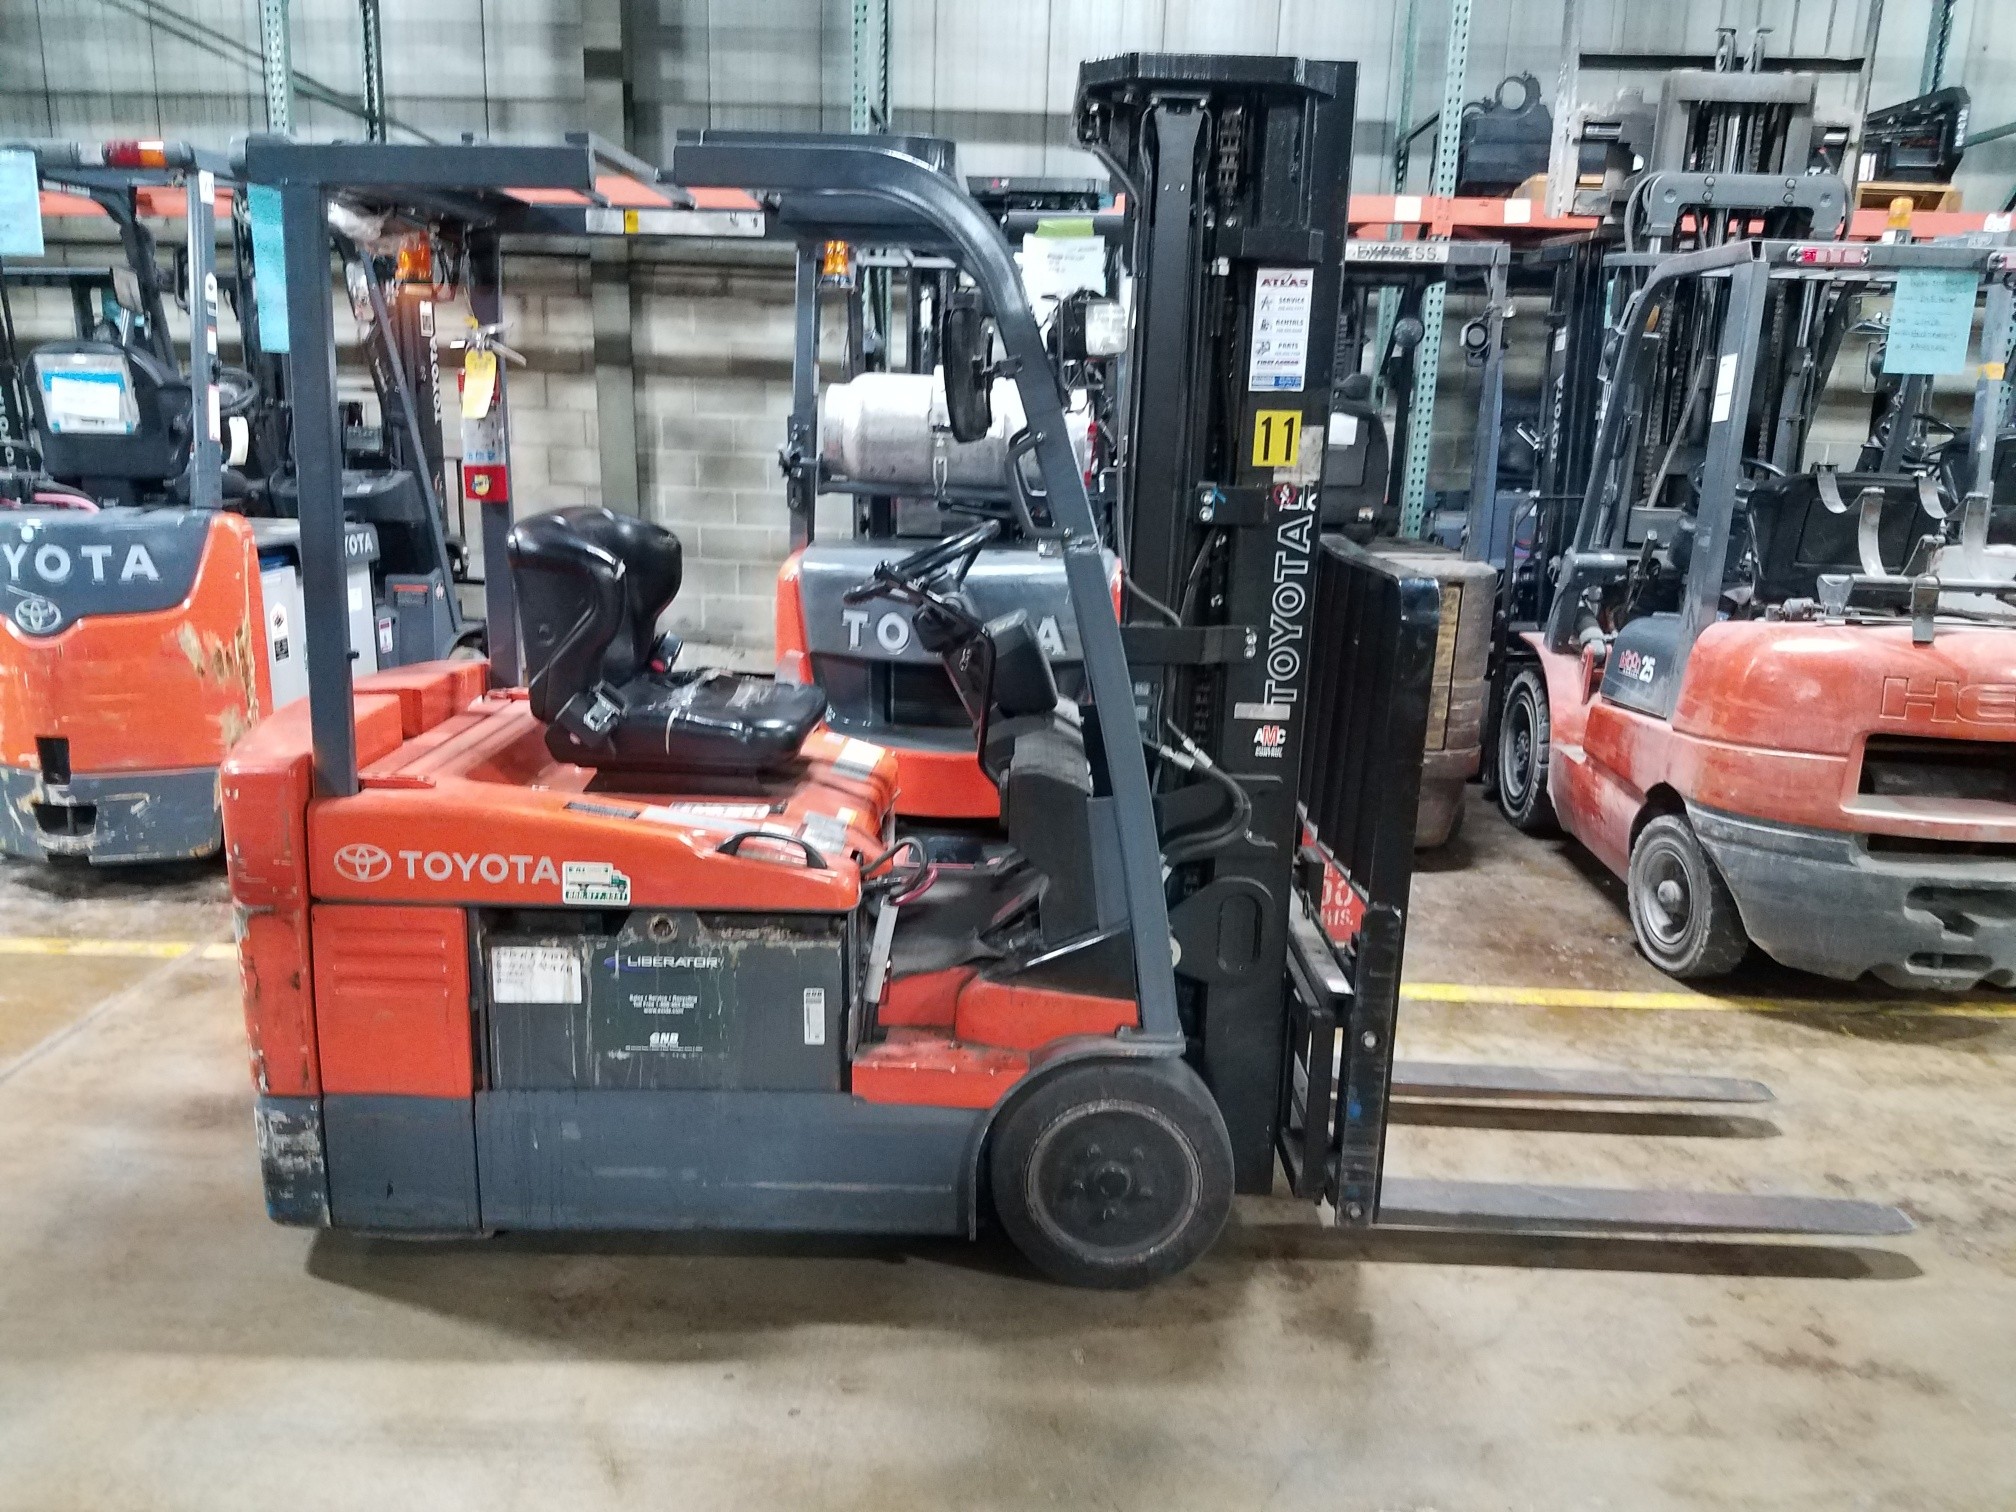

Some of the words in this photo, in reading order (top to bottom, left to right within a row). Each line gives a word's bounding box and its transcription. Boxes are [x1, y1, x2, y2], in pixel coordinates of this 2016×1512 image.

[1261, 279, 1308, 288] ATLAS
[1550, 373, 1565, 463] TOYOTA
[1261, 416, 1295, 462] 11
[1263, 514, 1314, 707] TOYOTA
[1639, 655, 1656, 683] 25
[1253, 724, 1287, 747] AMC
[399, 849, 561, 886] TOYOTA
[627, 955, 718, 969] LIBERATOR
